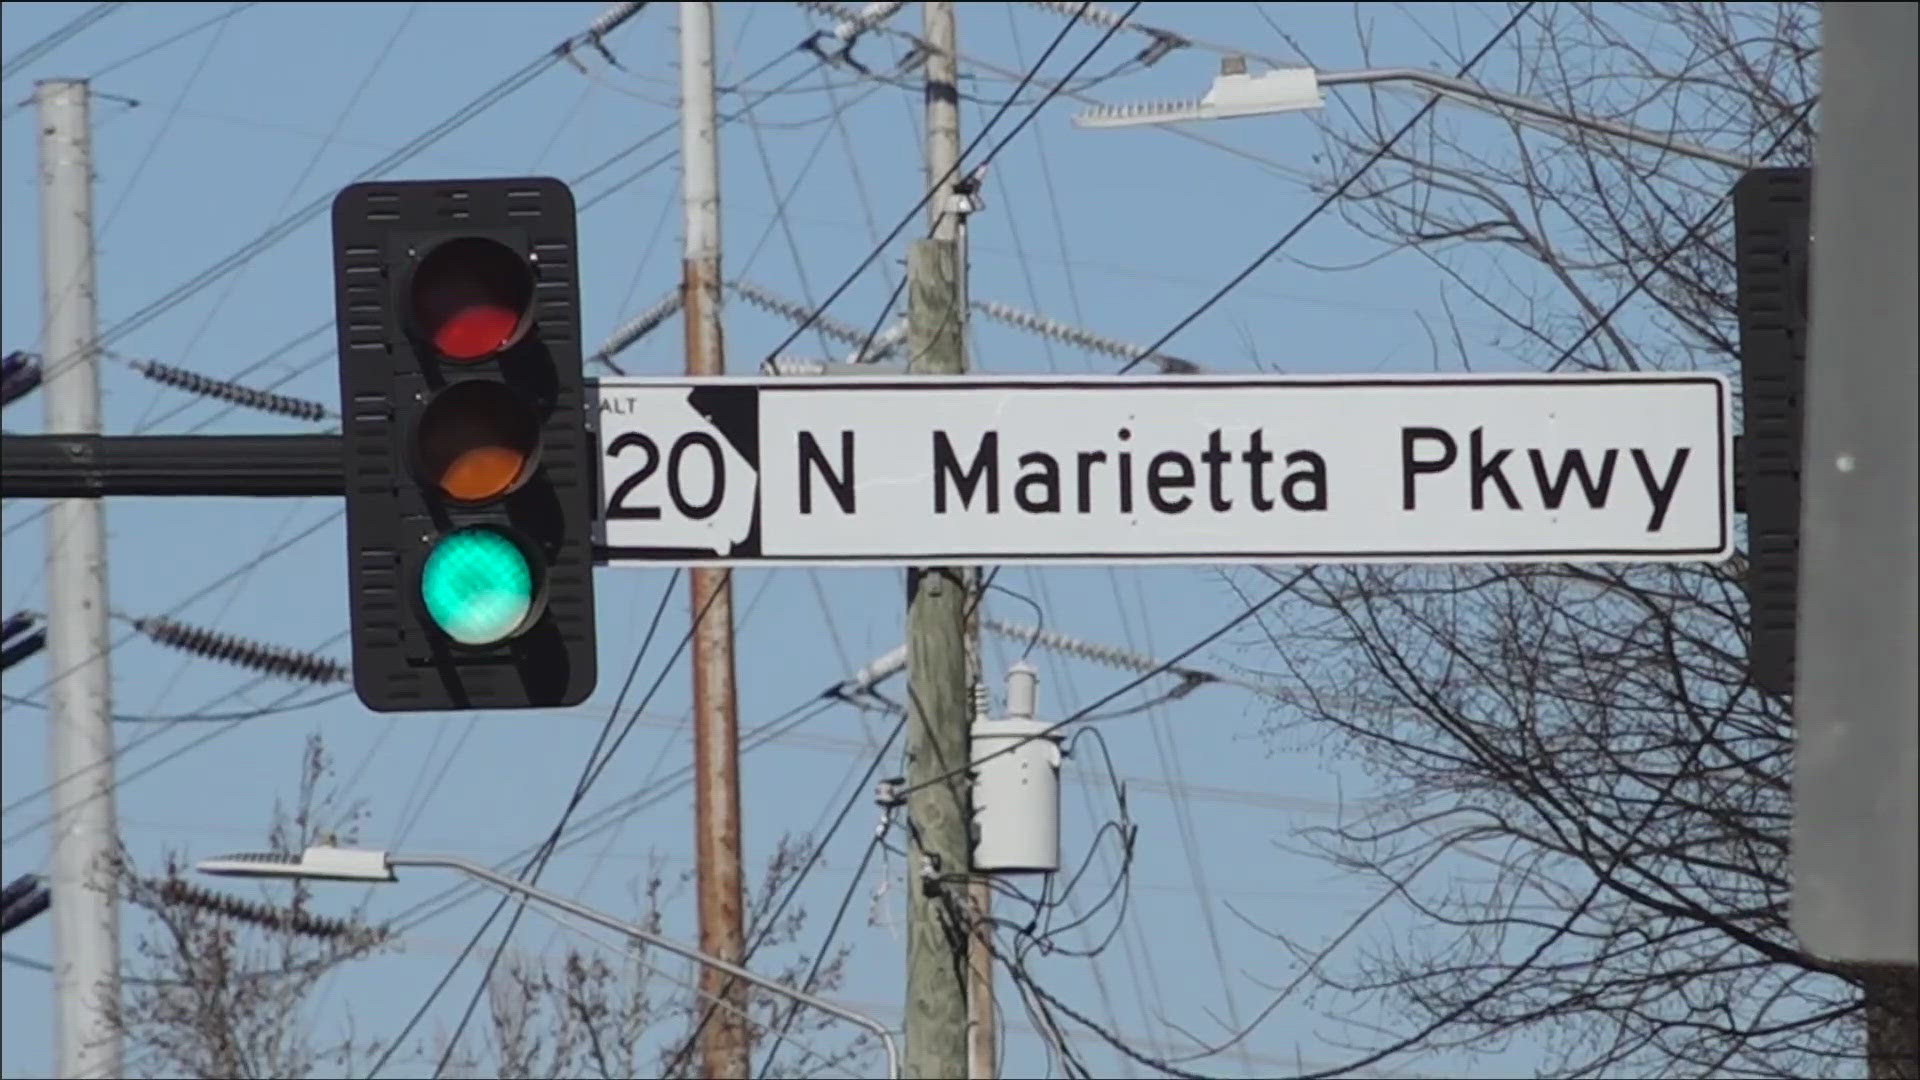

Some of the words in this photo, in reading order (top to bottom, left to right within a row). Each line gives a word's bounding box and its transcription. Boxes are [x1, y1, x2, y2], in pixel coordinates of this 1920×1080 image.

[600, 397, 637, 414] ALT
[605, 431, 726, 520] 20
[798, 430, 856, 515] N
[933, 428, 1328, 515] Marietta
[1401, 426, 1692, 533] Pkwy
